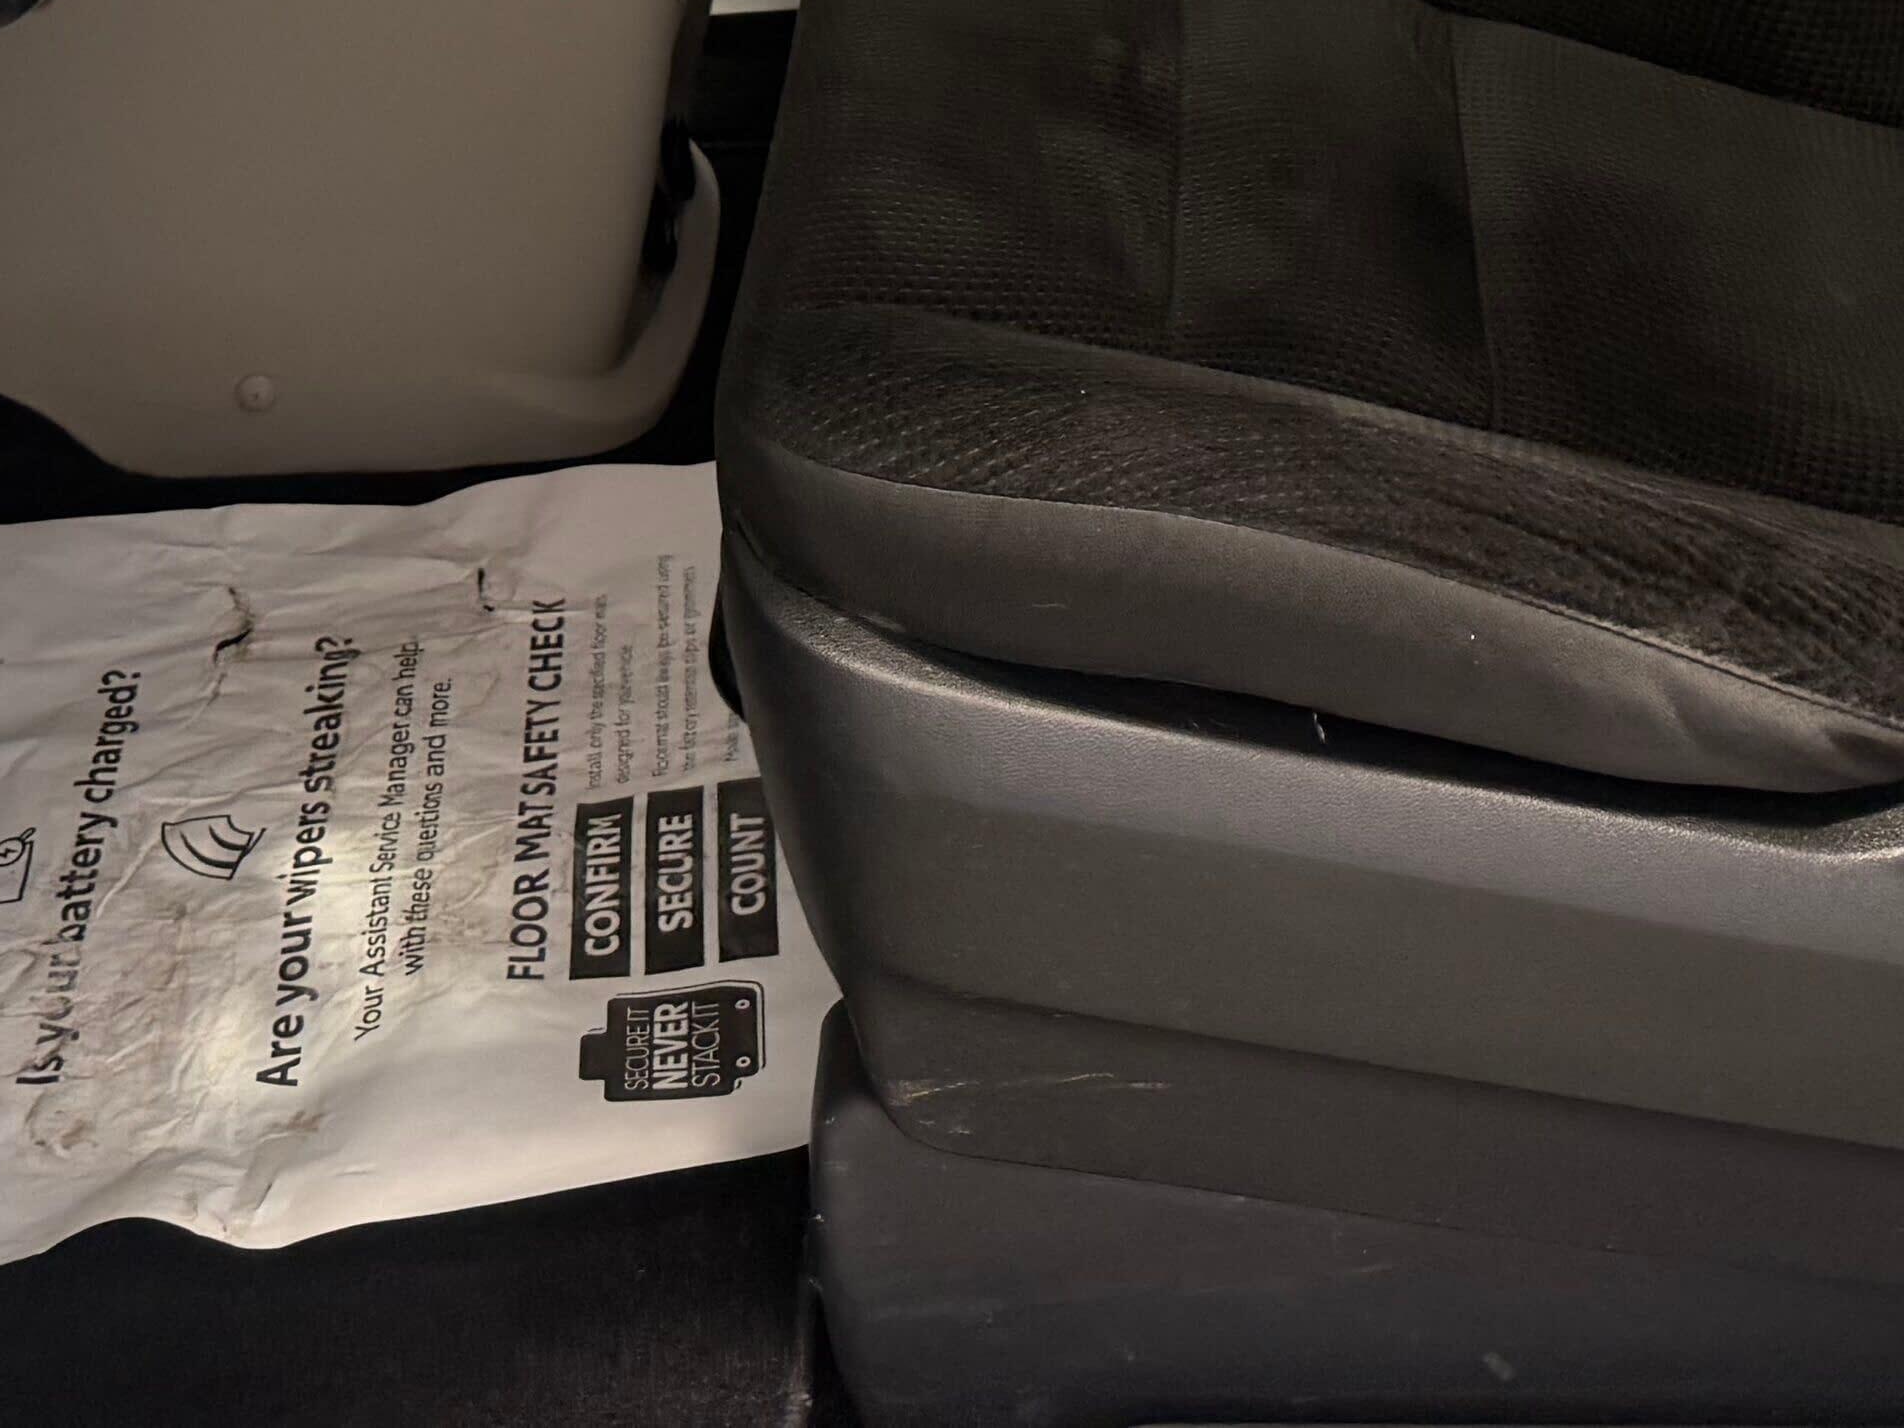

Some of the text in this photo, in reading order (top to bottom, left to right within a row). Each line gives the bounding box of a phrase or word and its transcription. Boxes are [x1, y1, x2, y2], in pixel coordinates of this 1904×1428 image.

[394, 684, 414, 718] can
[378, 722, 415, 808] Manager
[506, 597, 566, 981] FLOOR MAT SAFETY CHECK
[15, 669, 142, 1085] Is your battery charged?
[256, 635, 361, 1088] Are your wipers streaking?
[369, 811, 402, 873] Service
[399, 677, 452, 977] with these questions and more.
[657, 813, 694, 933] SECURE
[730, 812, 768, 916] COUNT
[359, 875, 393, 977] Assistant
[584, 812, 622, 957] CONFIRM
[354, 985, 384, 1041] Your
[624, 1005, 650, 1090] SECURE IT
[652, 1001, 689, 1090] NEVER
[691, 1001, 721, 1088] STACK IT
